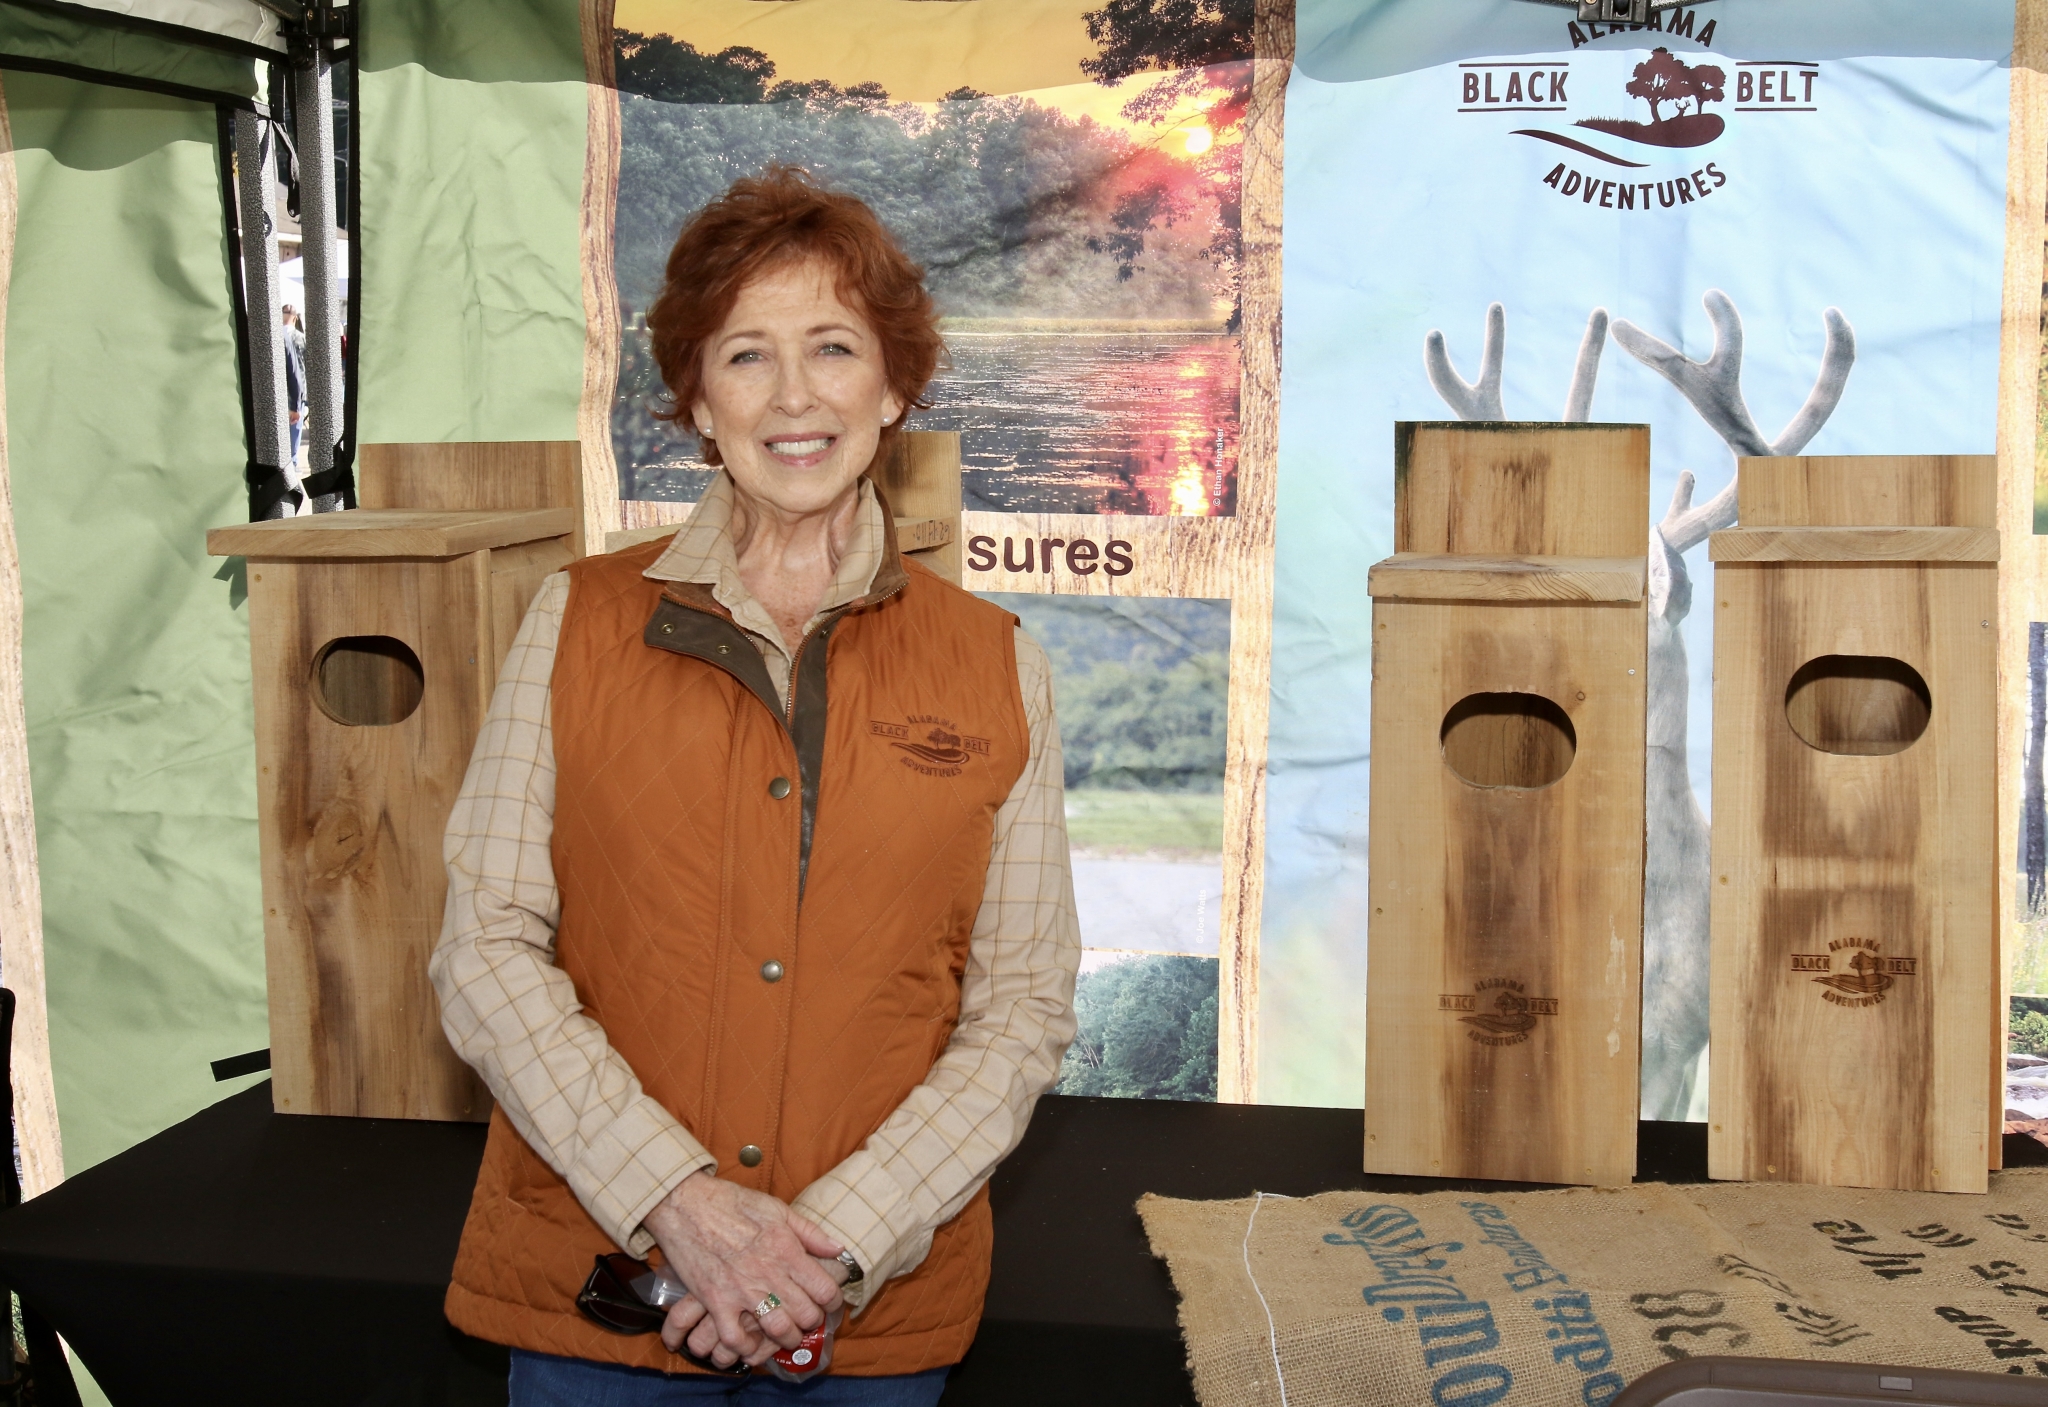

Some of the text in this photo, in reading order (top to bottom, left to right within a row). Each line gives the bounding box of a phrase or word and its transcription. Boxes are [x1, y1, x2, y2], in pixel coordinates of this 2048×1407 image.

[1568, 7, 1717, 48] ALAMA
[1463, 71, 1819, 103] BLACK BELT
[1543, 162, 1727, 210] ADVENTURES
[1215, 427, 1224, 467] Honaker
[1213, 469, 1222, 496] Ethan
[967, 535, 1134, 576] sures
[907, 715, 957, 731] ALABAMA
[871, 722, 991, 753] BLACK BELT
[901, 756, 962, 777] ADVENTURES
[1197, 889, 1207, 915] Watts
[1196, 917, 1205, 934] Joe
[1828, 937, 1880, 953] ALABAMA
[1792, 956, 1917, 972] BLACK BELT
[1474, 978, 1525, 993] ALABAMA
[1439, 996, 1559, 1013] BLACK BELT
[1821, 990, 1886, 1008] ADVENTURES
[1322, 1204, 1467, 1306] Dreyfus
[1460, 1201, 1626, 1407] oditi Honduras
